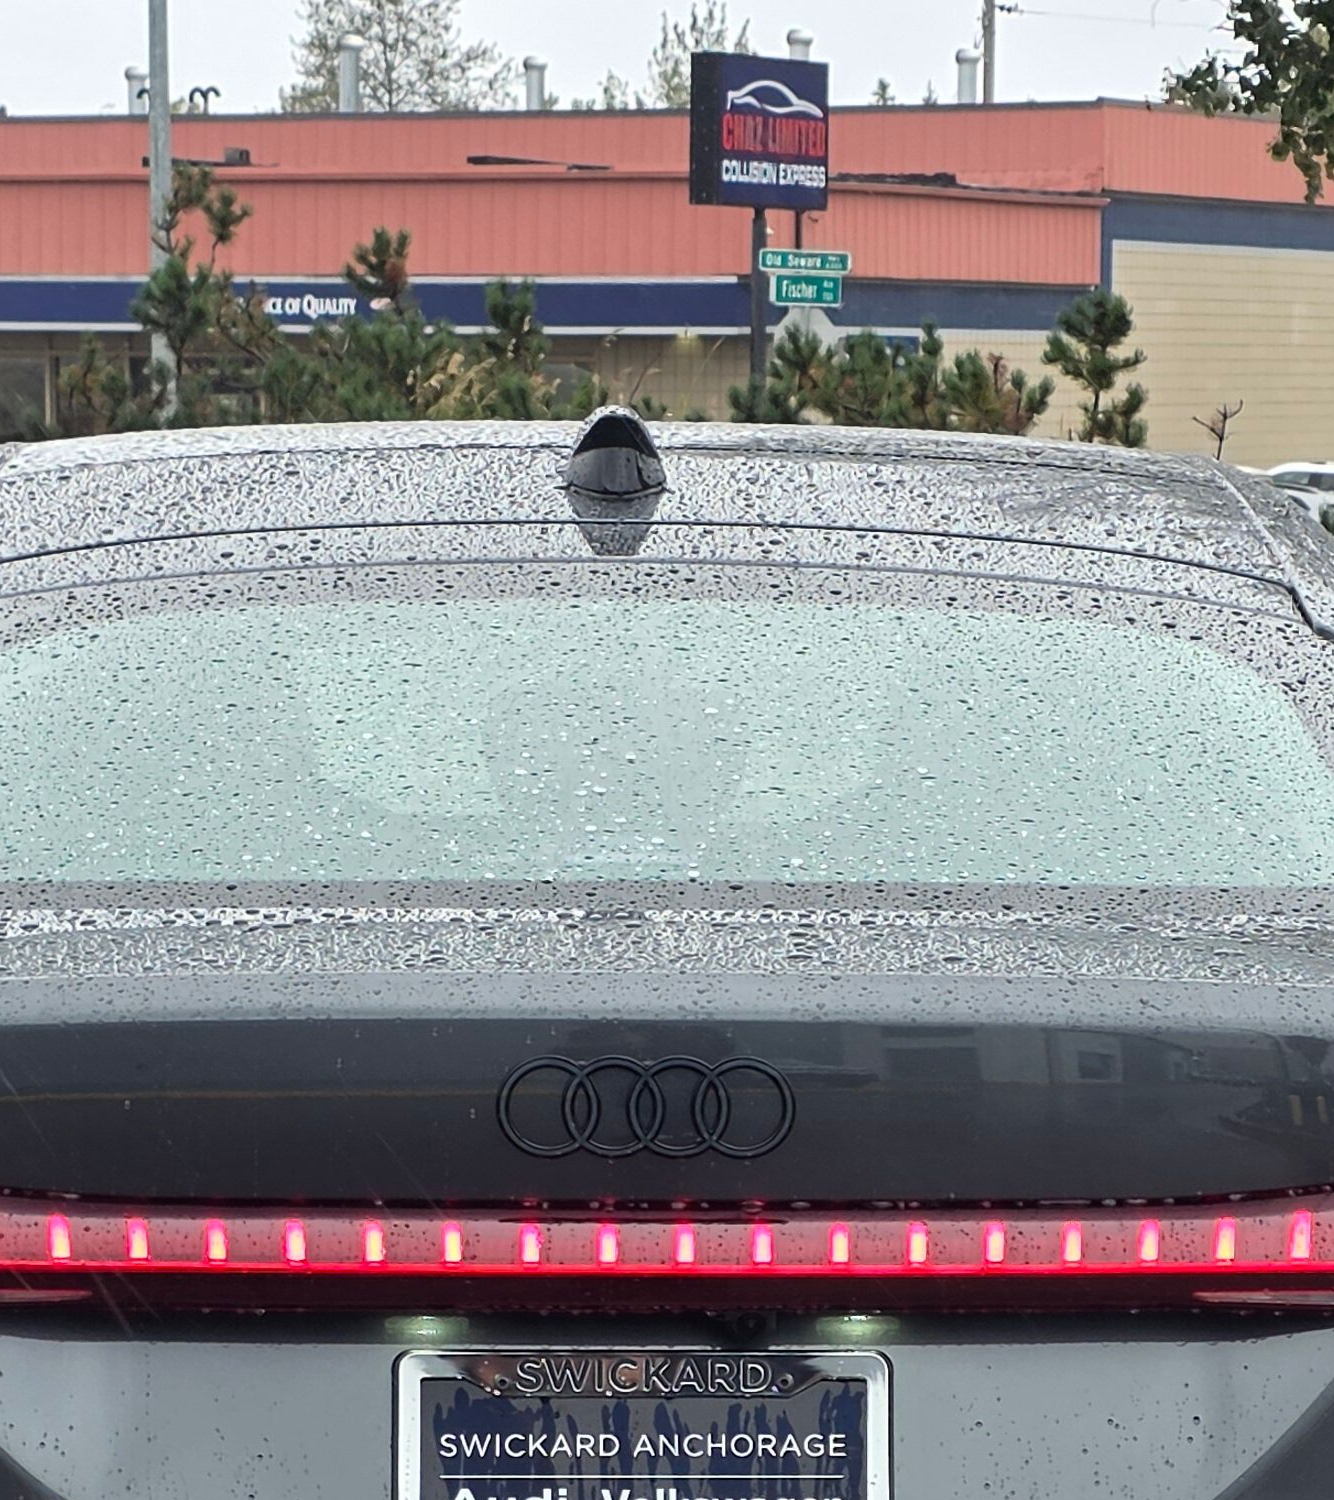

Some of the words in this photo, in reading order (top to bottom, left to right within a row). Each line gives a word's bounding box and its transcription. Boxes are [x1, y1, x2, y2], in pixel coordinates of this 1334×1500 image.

[723, 113, 764, 151] CHAZ
[768, 117, 826, 156] LIMITED
[722, 159, 777, 185] COLLISION
[779, 163, 826, 188] EXPRESS
[766, 253, 782, 267] Old
[782, 279, 818, 299] Fischer
[285, 297, 301, 315] OF
[302, 294, 357, 319] QUALITY
[515, 1356, 773, 1394] SWICKARD
[439, 1433, 621, 1458] SWICKARD
[633, 1433, 848, 1458] ANCHORAGE
